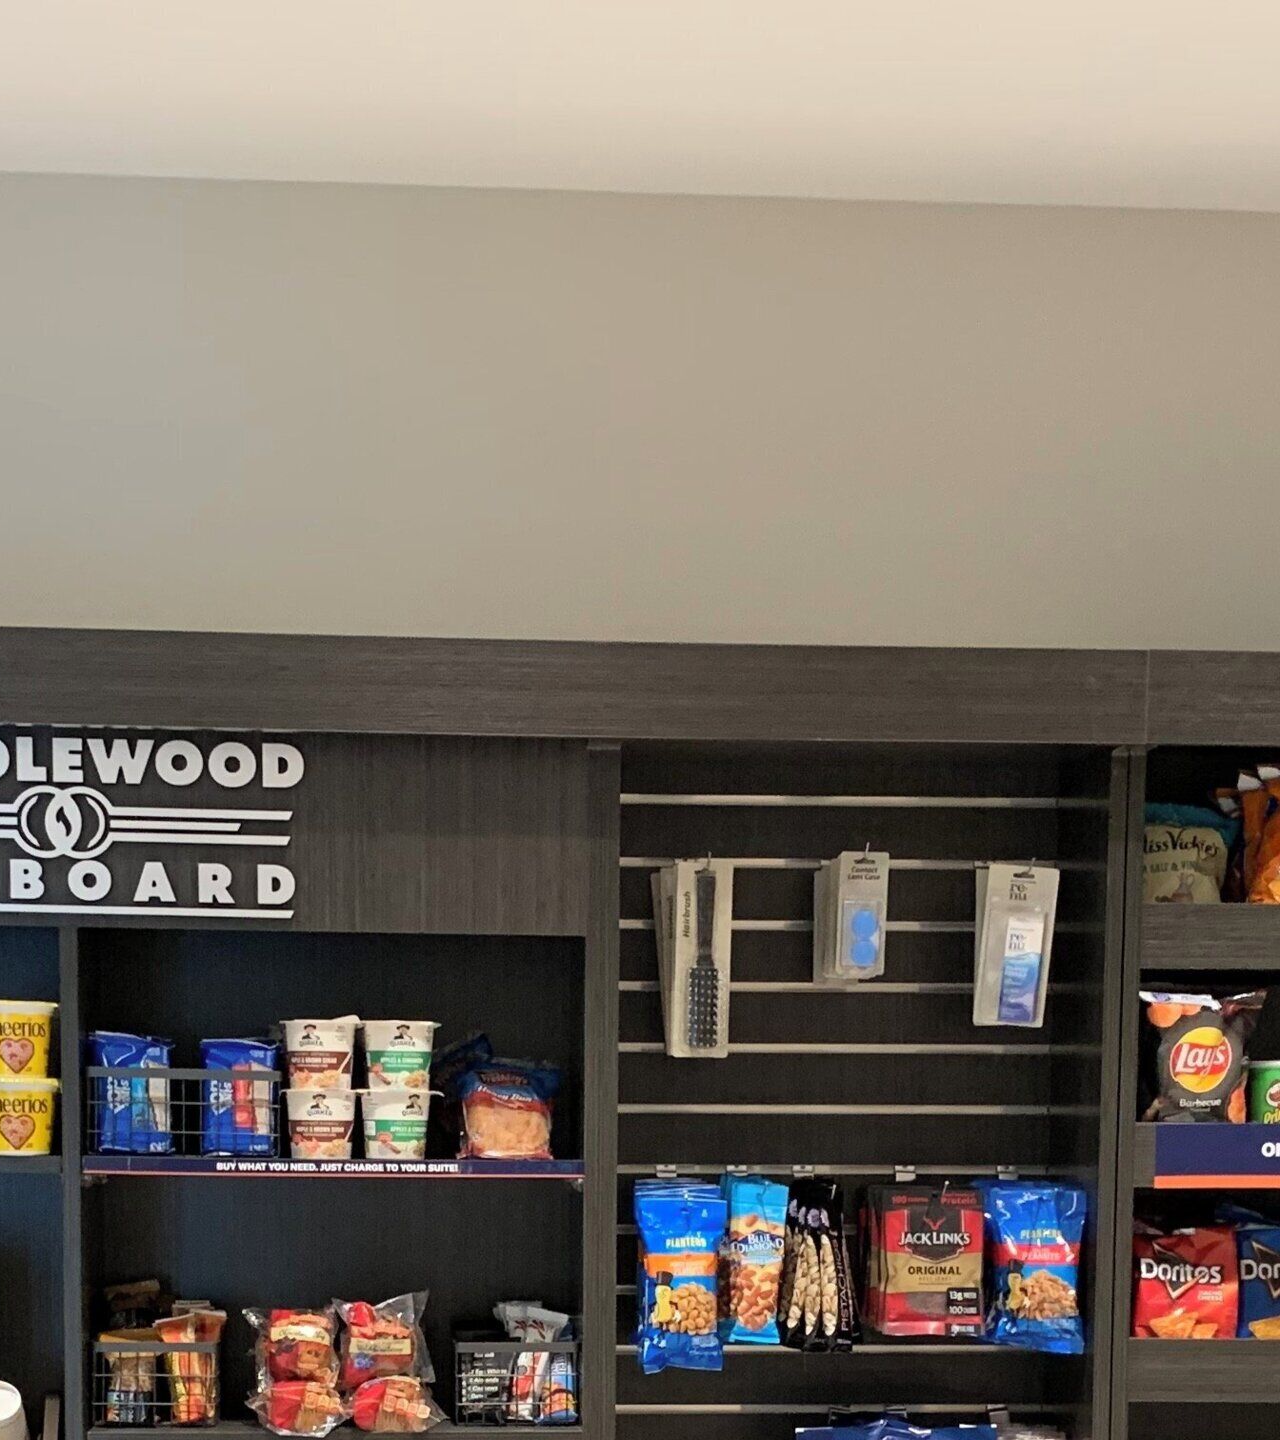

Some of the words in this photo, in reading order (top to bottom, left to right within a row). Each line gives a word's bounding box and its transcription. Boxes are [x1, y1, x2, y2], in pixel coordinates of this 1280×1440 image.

[683, 891, 692, 938] Hairbrush
[1179, 1098, 1222, 1108] Barbecue
[216, 1162, 236, 1171] BUY
[238, 1162, 266, 1171] WHAT
[269, 1162, 289, 1171] YOU
[290, 1162, 318, 1172] NEED.
[320, 1163, 343, 1172] JUST
[344, 1163, 384, 1172] CHARGE
[386, 1163, 398, 1172] TO
[400, 1164, 426, 1172] YOUR
[427, 1164, 459, 1173] SUITE!
[665, 1236, 707, 1249] PLANTERS
[748, 1233, 772, 1243] BLUE
[898, 1232, 932, 1245] JACK
[908, 1266, 962, 1275] ORIGINAL
[1140, 1258, 1222, 1284] Doritos
